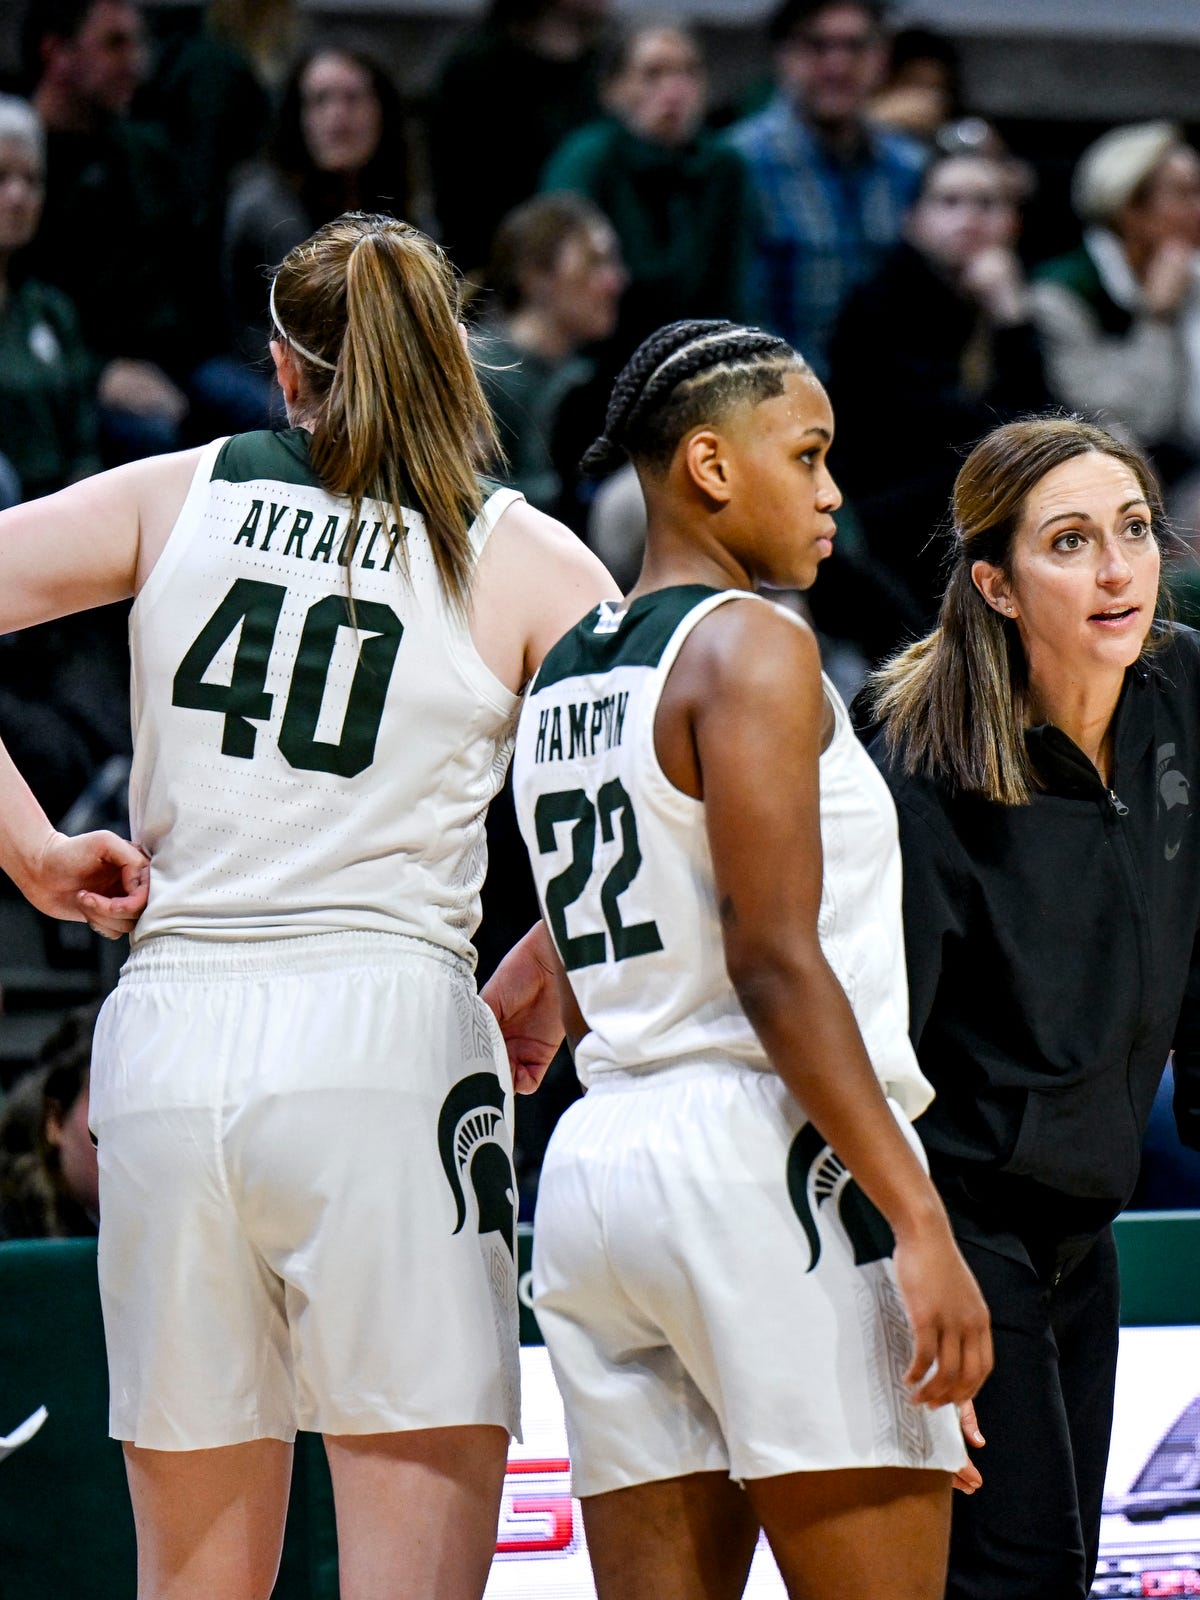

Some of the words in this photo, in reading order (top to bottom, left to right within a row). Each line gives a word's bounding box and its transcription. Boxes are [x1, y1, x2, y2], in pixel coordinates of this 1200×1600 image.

[233, 499, 410, 572] AYRAULT
[171, 577, 405, 779] 40
[534, 777, 665, 973] 22
